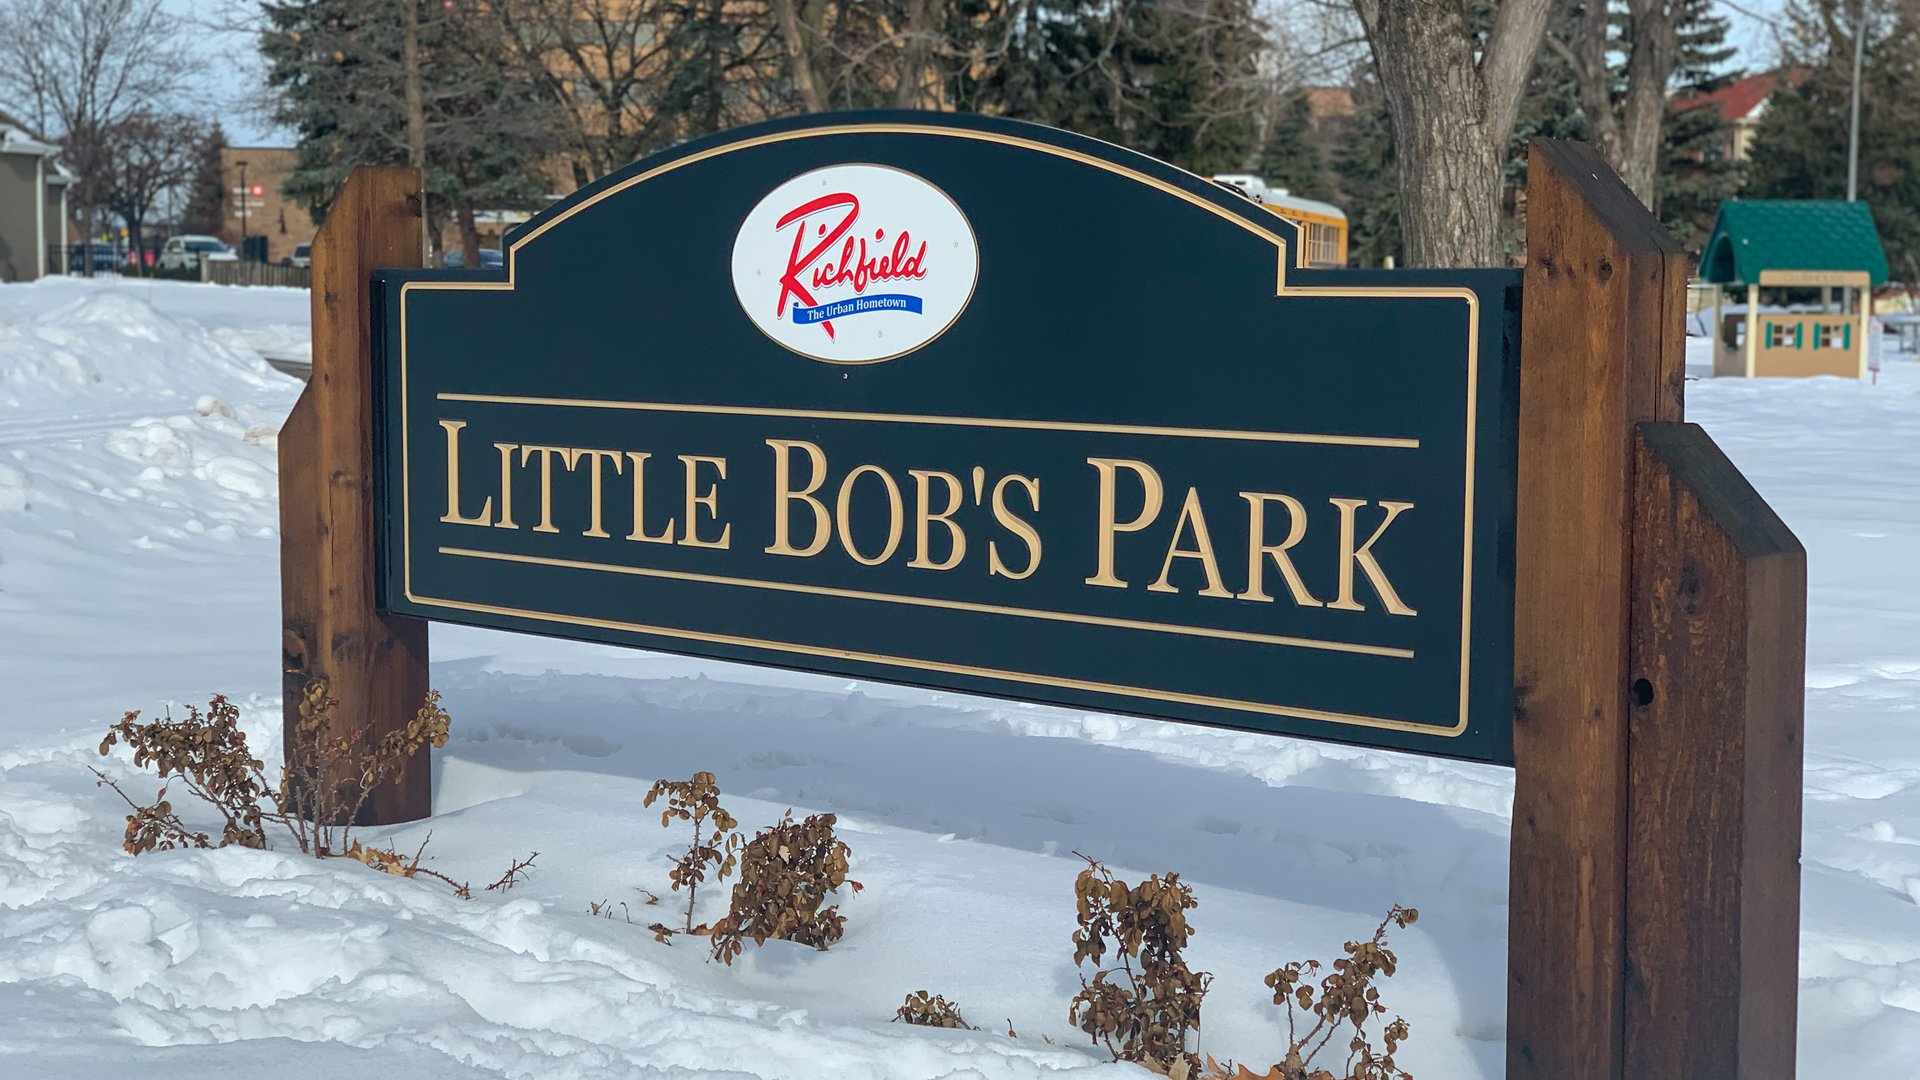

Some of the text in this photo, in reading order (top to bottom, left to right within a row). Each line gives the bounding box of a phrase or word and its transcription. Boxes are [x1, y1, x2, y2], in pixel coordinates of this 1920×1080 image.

[776, 192, 928, 338] Richfield
[807, 297, 907, 321] The Urban Hometown
[438, 419, 1417, 617] LITTLE BOB'S PARK
